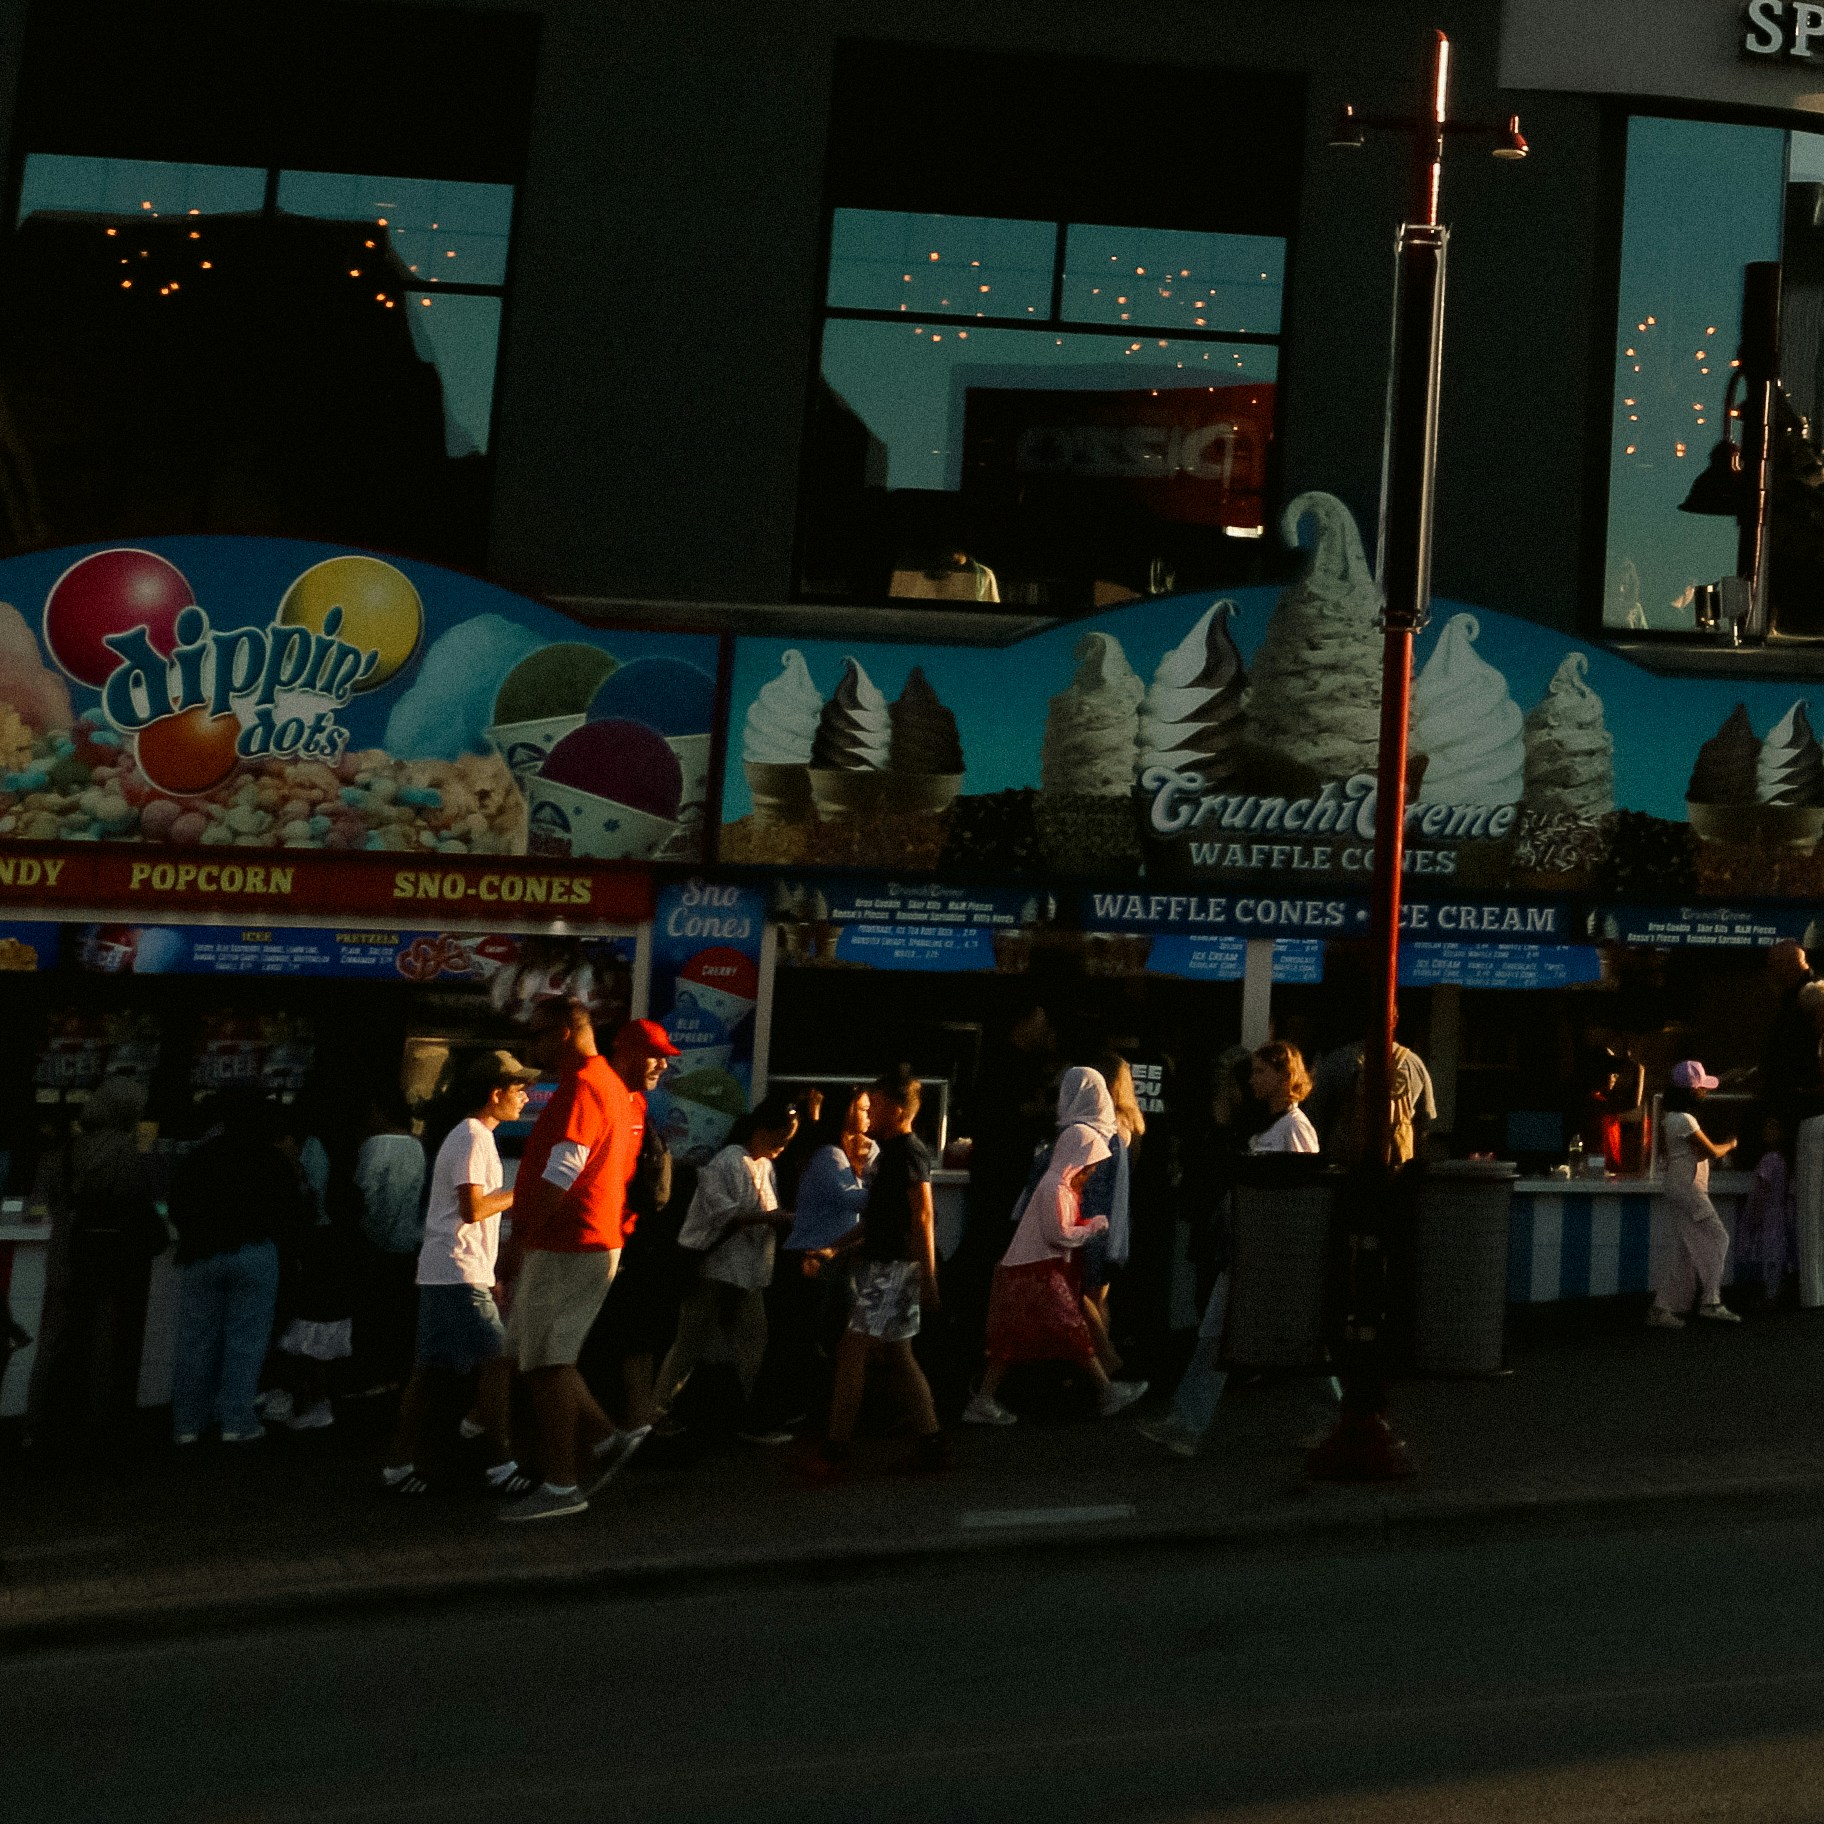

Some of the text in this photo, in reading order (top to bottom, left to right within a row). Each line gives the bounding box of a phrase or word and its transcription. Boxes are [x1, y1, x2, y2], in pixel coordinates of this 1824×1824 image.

[237, 707, 350, 766] dots
[1188, 842, 1332, 871] WAFFLE
[129, 861, 296, 895] POPCORN
[392, 870, 594, 905] SNO-CONES
[680, 878, 743, 907] Sno
[665, 905, 752, 939] Cones
[1092, 892, 1557, 933] WAFFLE CONES CE CREAM
[1131, 1063, 1163, 1080] EE
